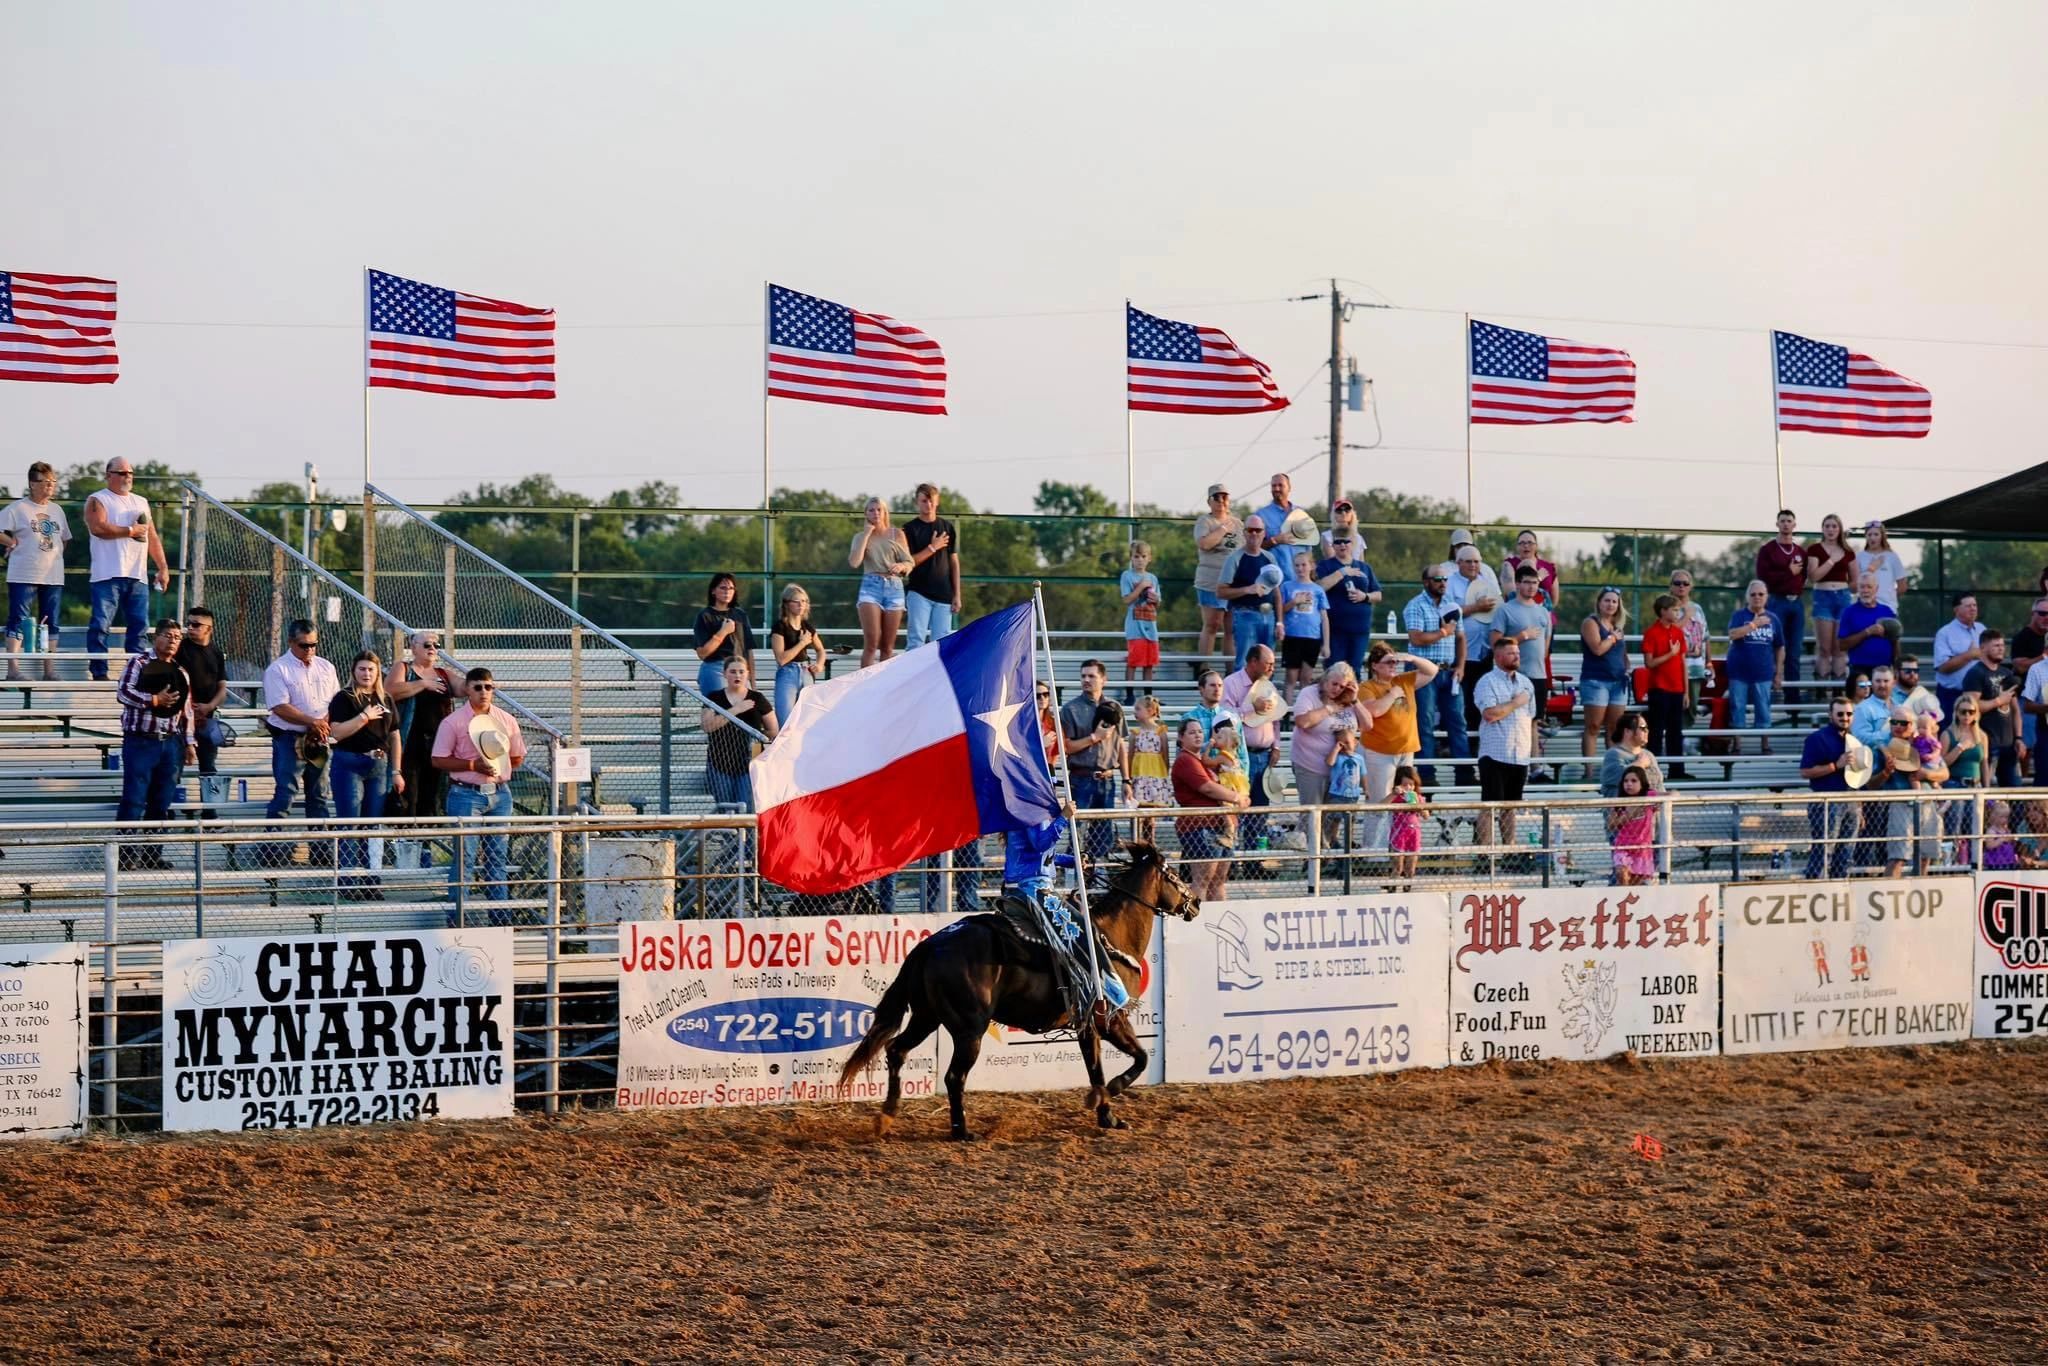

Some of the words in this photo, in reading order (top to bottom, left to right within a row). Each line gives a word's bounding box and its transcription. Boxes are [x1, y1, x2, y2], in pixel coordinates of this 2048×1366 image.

[1743, 893, 1850, 926] CZECH
[1868, 889, 1943, 921] STOP
[1264, 906, 1413, 951] SHILLING
[1455, 891, 1713, 973] Westfest
[622, 924, 712, 972] Jaska
[725, 922, 814, 968] Dozer
[255, 938, 427, 1003] CHAD
[1275, 961, 1309, 980] PIPE
[1312, 960, 1322, 977] &
[1378, 956, 1405, 975] INC.
[733, 973, 759, 989] House
[761, 972, 782, 988] Pads
[794, 972, 836, 991] Driveways
[1474, 981, 1529, 1003] Czech
[1641, 974, 1698, 996] LABOR
[1981, 974, 2048, 999] COMME
[0, 1003, 25, 1012] OOP
[28, 1000, 49, 1010] 340
[625, 1011, 646, 1035] Tree
[644, 1005, 652, 1024] &
[651, 993, 673, 1019] Land
[671, 979, 708, 1007] Clearing
[1653, 1004, 1686, 1024] DAY
[15, 1016, 49, 1027] 76706
[672, 1018, 709, 1034] (254)
[1136, 1011, 1162, 1026] Inc.
[1817, 1006, 1887, 1039] CZECH
[1895, 1001, 1969, 1035] BAKERY
[174, 995, 503, 1067] MYNARCIK
[1208, 1024, 1410, 1075] 254-829-2433
[1460, 1041, 1474, 1062] &
[1481, 1041, 1540, 1060] Dance
[1625, 1031, 1713, 1054] WEEKEND
[0, 1052, 40, 1065] SBECK
[792, 1058, 825, 1075] Custom
[985, 1052, 1029, 1070] Keeping
[1033, 1051, 1051, 1064] You
[1055, 1049, 1082, 1063] Ahea
[17, 1074, 38, 1084] 789
[175, 1066, 303, 1101] CUSTOM
[310, 1061, 379, 1094] HAY
[388, 1054, 503, 1089] BALING
[625, 1066, 635, 1082] 18
[636, 1065, 668, 1081] Wheeler
[677, 1064, 699, 1083] Heavy
[701, 1063, 730, 1082] Hauling
[732, 1062, 758, 1079] Service
[5, 1090, 21, 1100] TX
[27, 1088, 62, 1099] 76642
[901, 1076, 933, 1095] ork
[241, 1092, 440, 1130] 254-722-2134
